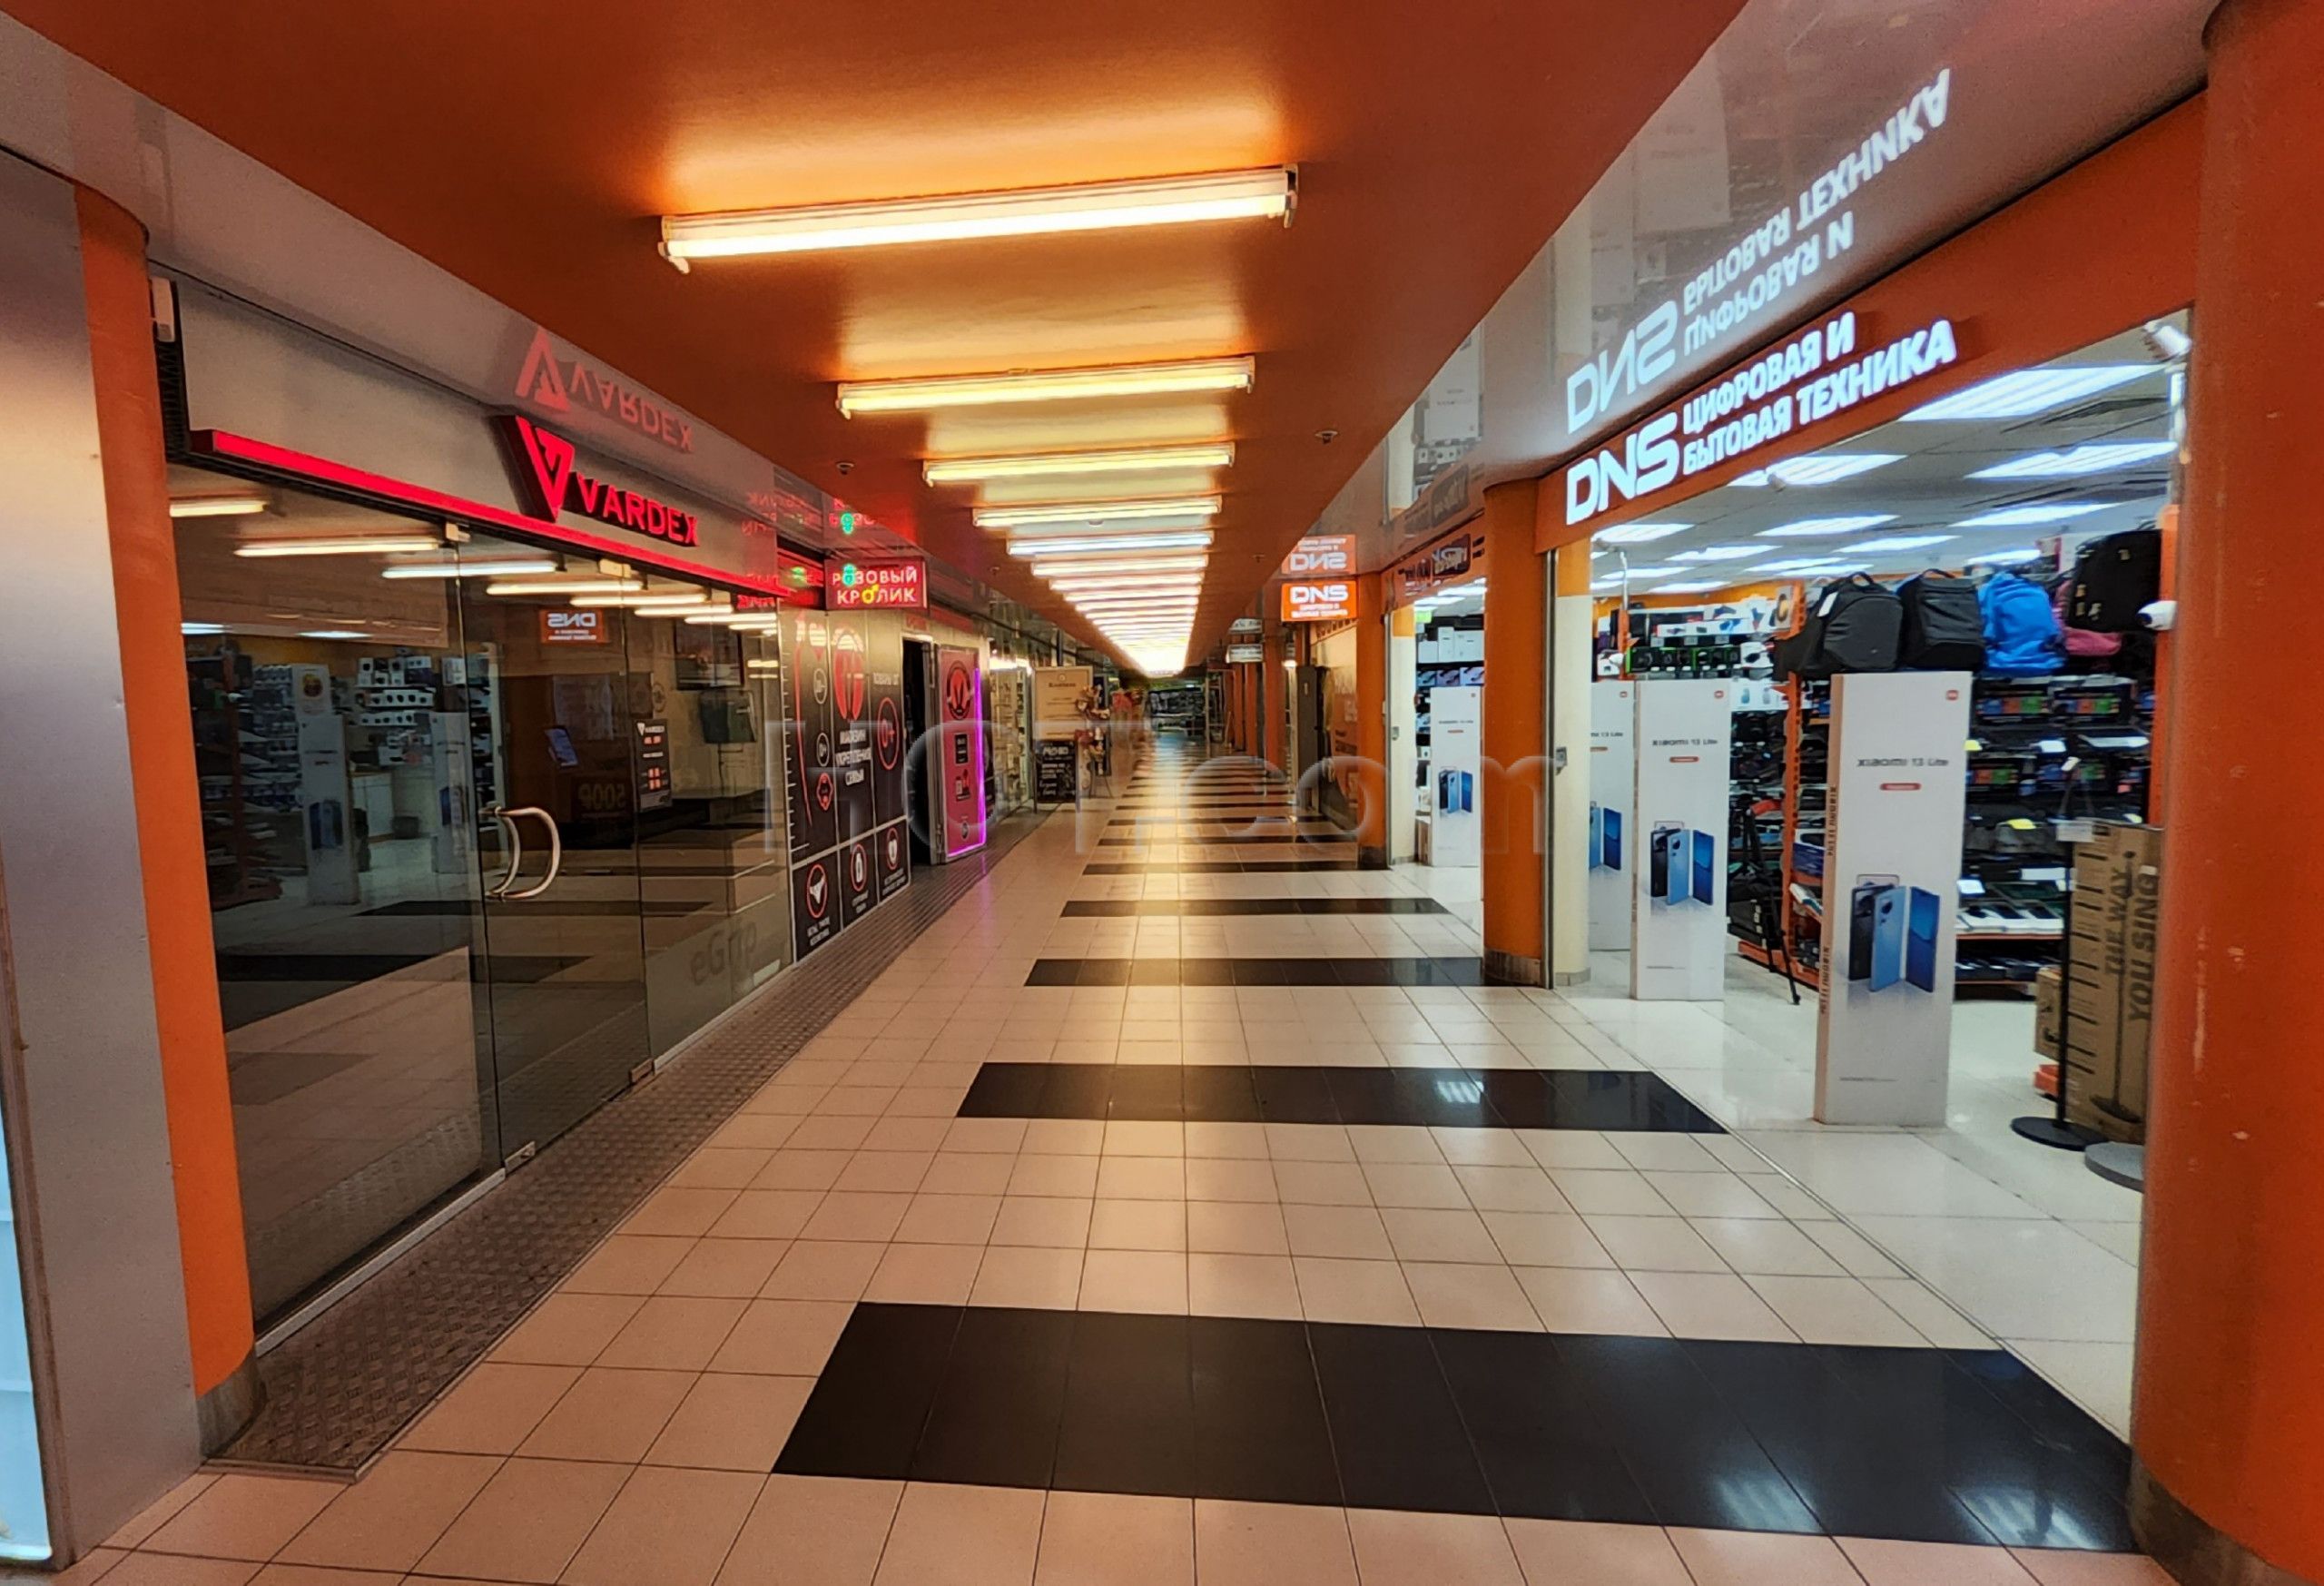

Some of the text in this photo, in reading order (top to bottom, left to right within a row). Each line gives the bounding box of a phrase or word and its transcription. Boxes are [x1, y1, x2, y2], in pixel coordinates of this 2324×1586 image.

[1682, 319, 1957, 476] БЫТОВАЯ ТЕХНИКА
[1683, 311, 1855, 433] ЦИФРОВАЯ И
[576, 471, 698, 546] VARDEX
[1566, 412, 1679, 525] DNS
[837, 584, 917, 605] КРОЛИК
[1290, 585, 1348, 604] DNS
[2128, 871, 2159, 1022] YOU SING
